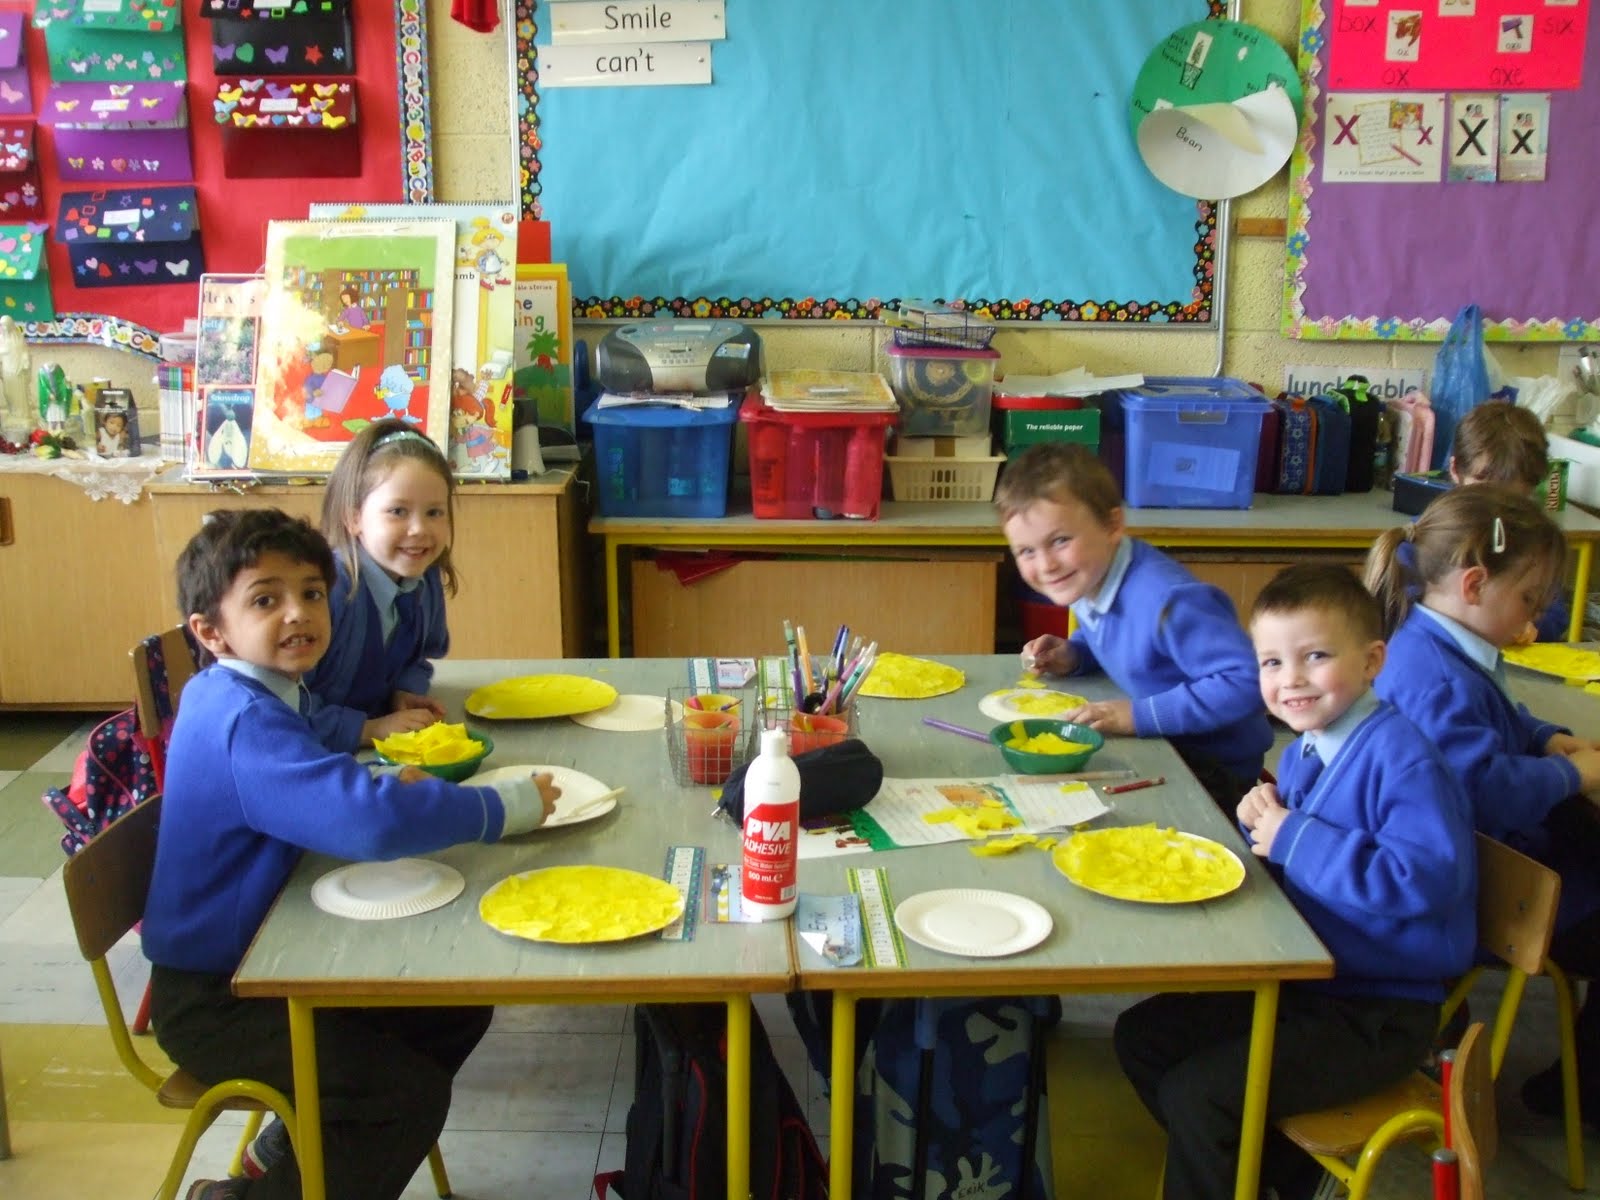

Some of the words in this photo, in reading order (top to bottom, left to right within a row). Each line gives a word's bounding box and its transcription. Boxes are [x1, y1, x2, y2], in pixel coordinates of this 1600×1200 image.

[604, 5, 672, 30] Smile
[1338, 6, 1377, 32] box
[1544, 17, 1573, 34] six
[596, 48, 655, 73] can't
[1383, 67, 1409, 87] ox
[1175, 126, 1203, 152] Bean
[211, 392, 251, 403] Snowdrop
[1369, 378, 1418, 399] able
[746, 817, 791, 841] PVA
[744, 838, 792, 855] ADHESIVE
